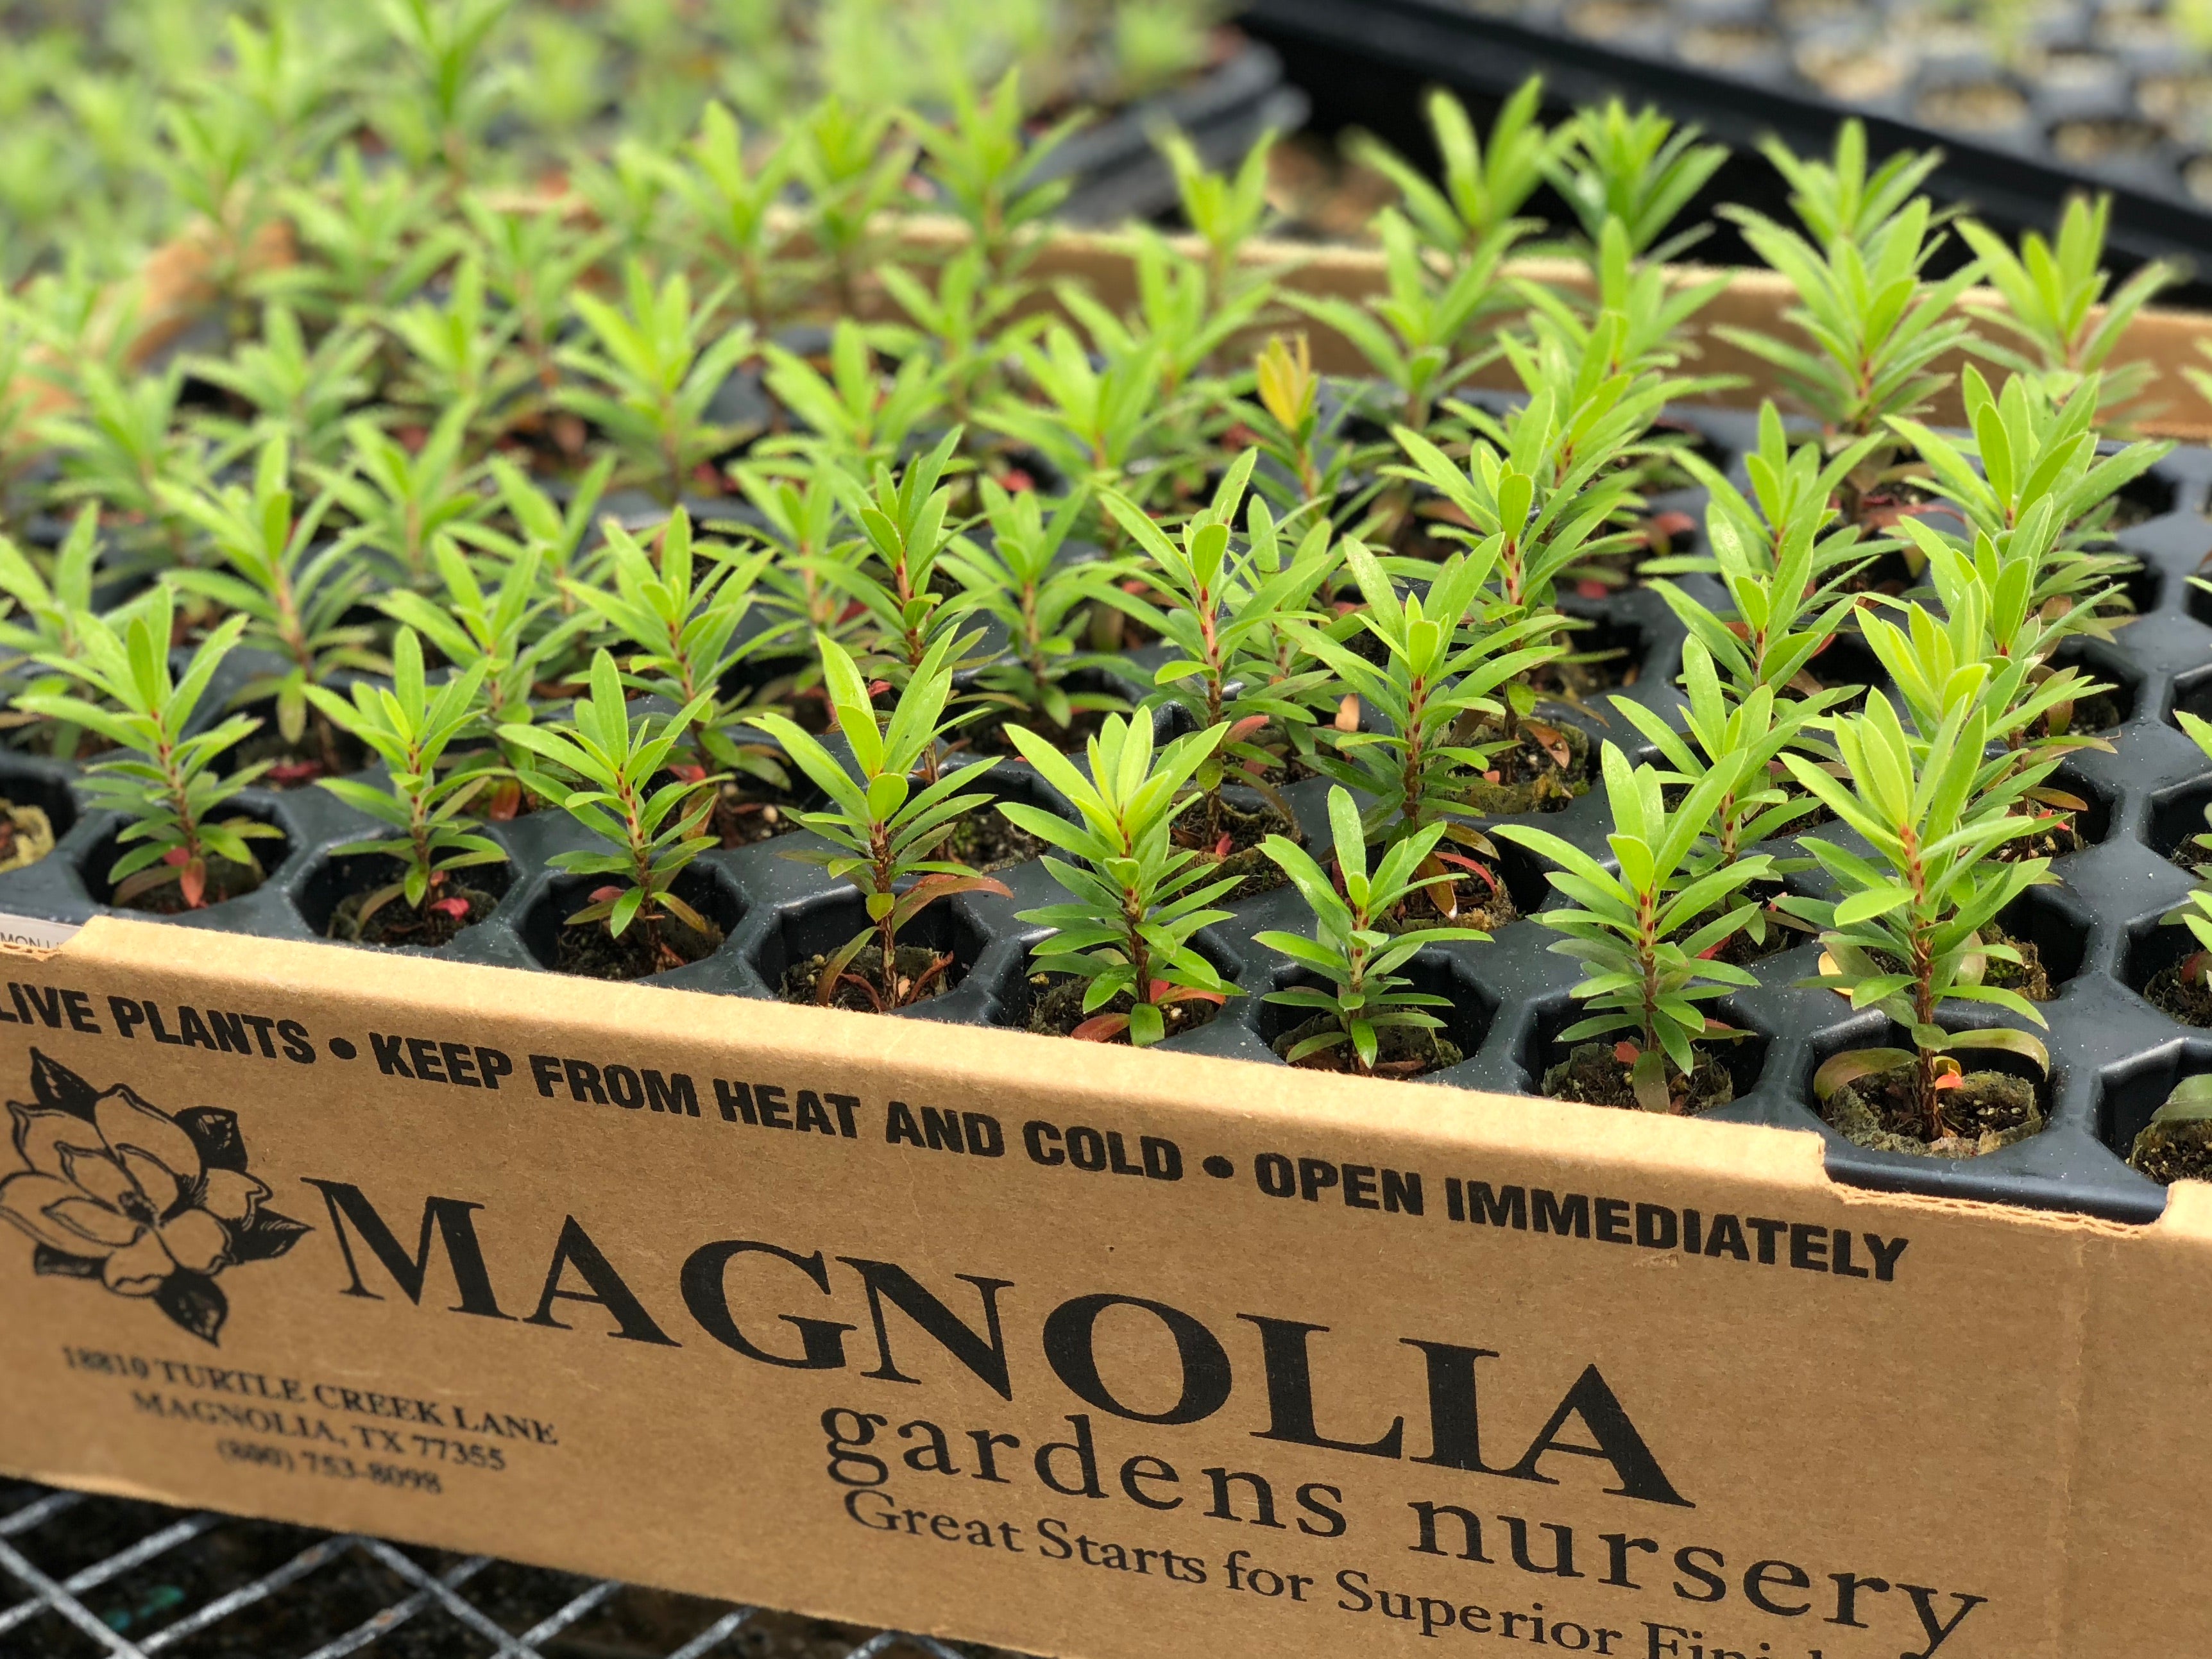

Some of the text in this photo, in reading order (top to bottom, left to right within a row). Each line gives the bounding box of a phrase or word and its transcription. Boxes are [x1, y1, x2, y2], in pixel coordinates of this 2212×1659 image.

[0, 982, 1909, 1282] IVE PLANTS KEEP FROM HEAT AND COLD OPEN IMMEDIATELY
[132, 1390, 506, 1472] MAGNOLIA, TX 77355
[153, 1358, 306, 1403] TURTLE
[312, 1384, 446, 1428] CREEK
[452, 1406, 558, 1447] LANE
[300, 1177, 1696, 1509] MAGNOLIA
[821, 1407, 1989, 1659] gardens nursery
[844, 1489, 1024, 1552] Great
[1037, 1518, 1207, 1584] Starts
[1222, 1550, 1314, 1602] for
[1335, 1569, 1623, 1656] Superior
